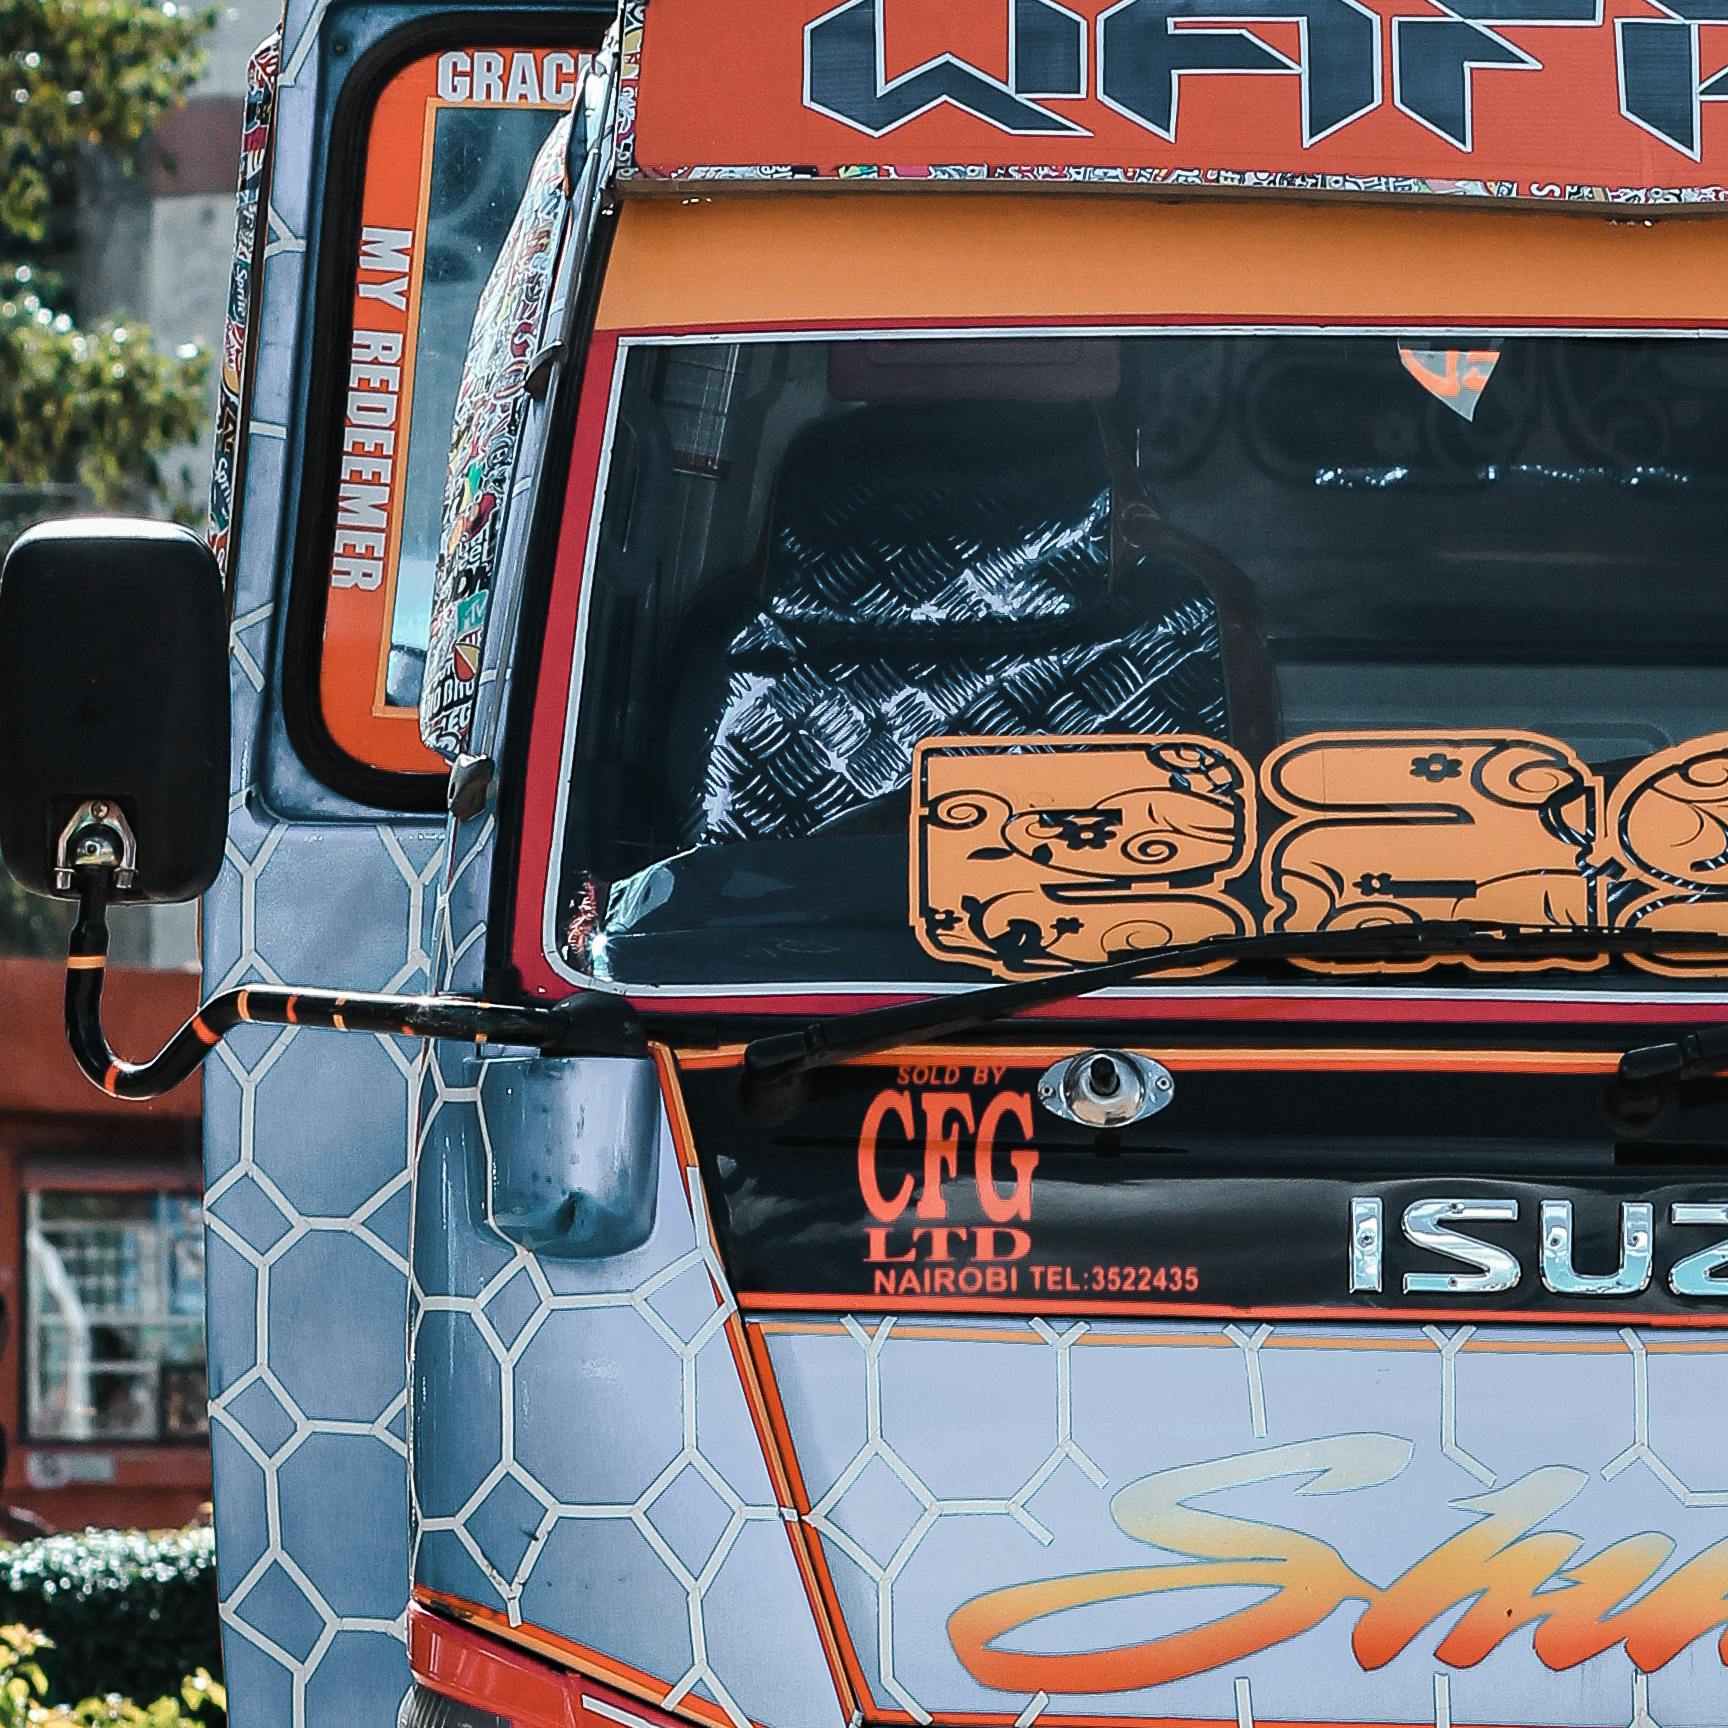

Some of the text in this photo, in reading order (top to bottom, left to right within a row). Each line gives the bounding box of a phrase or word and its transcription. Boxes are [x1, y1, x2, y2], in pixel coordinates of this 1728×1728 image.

[329, 225, 412, 592] MY REDEEMER
[897, 1065, 1006, 1085] SOLD BY
[858, 1089, 1040, 1222] CFG
[864, 1225, 1032, 1263] LTD
[873, 1264, 1200, 1294] NAIROBI TEL:3522435
